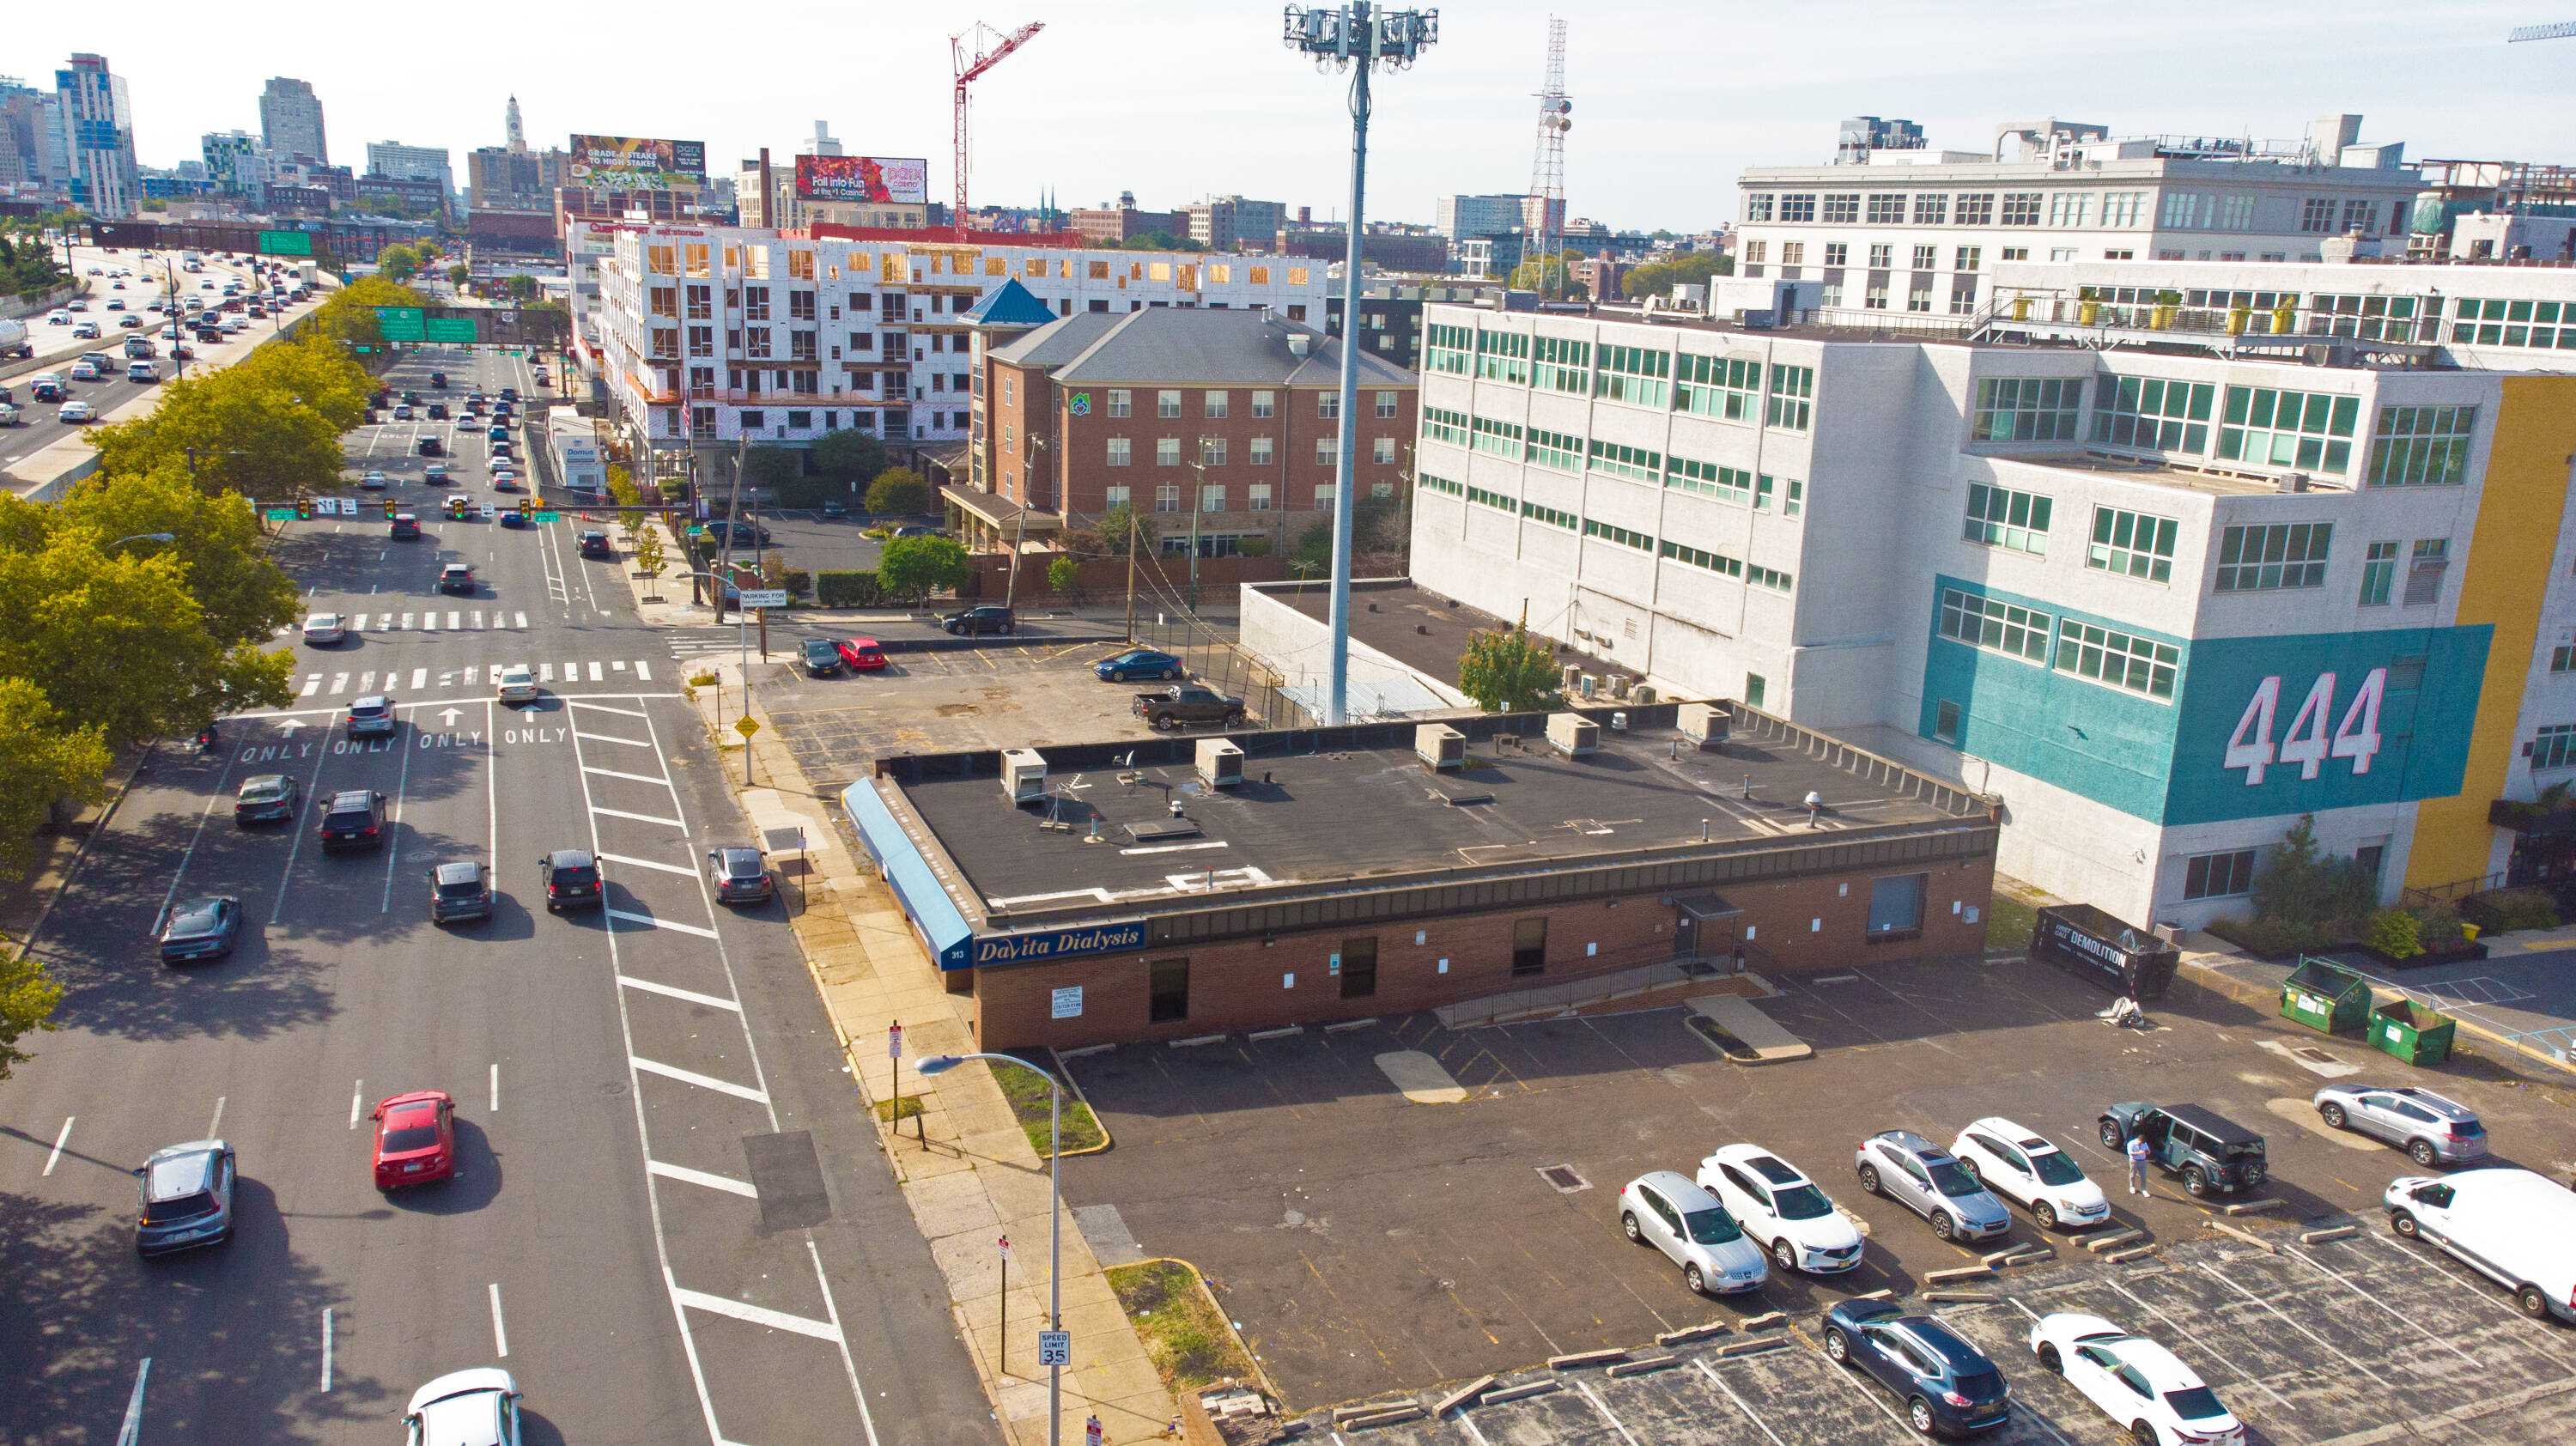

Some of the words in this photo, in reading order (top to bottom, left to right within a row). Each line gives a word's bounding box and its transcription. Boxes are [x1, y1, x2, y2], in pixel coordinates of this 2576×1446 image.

[587, 149, 625, 159] GRADE-A
[626, 159, 657, 168] STAKES
[812, 176, 829, 187] Fall
[829, 177, 848, 188] into
[848, 178, 865, 189] Fun
[887, 167, 923, 183] parx
[2224, 668, 2387, 786] 444
[419, 731, 482, 749] ONLY
[505, 727, 566, 744] ONLY
[240, 743, 313, 762] ONLY
[333, 737, 397, 755] ONLY
[2055, 930, 2068, 939] CALL
[2056, 924, 2072, 934] FIRST
[978, 937, 1049, 961] DaVita
[1055, 928, 1139, 952] Dialysis
[2069, 930, 2127, 969] DEMOLITION
[951, 951, 963, 959] 313
[1044, 1350, 1066, 1363] 35
